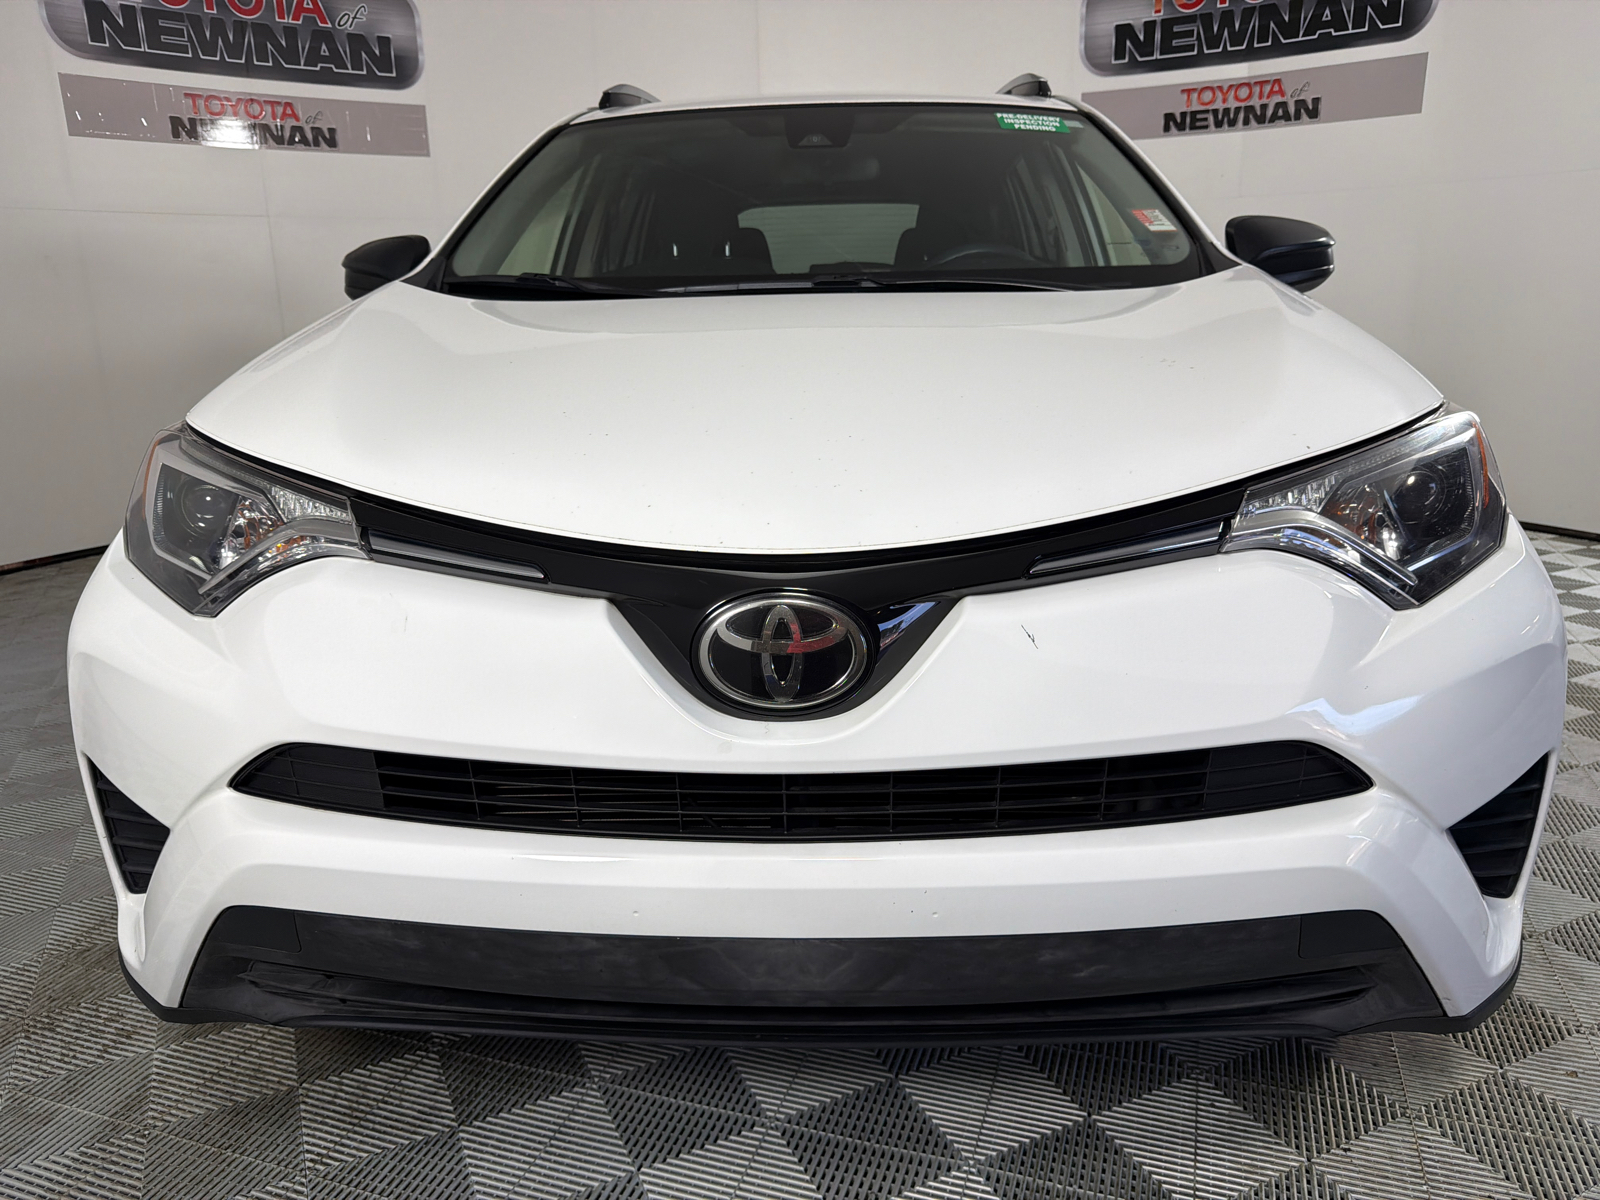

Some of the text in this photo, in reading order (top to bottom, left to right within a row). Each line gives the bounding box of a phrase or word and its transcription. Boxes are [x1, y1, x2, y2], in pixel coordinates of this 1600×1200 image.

[335, 4, 367, 30] of
[1112, 0, 1404, 64] NEWNAN
[83, 0, 396, 77] NEWNAN
[183, 92, 300, 122] TOYOTA
[1181, 78, 1286, 108] TOYOTA
[1004, 118, 1060, 127] INSPECTION
[1014, 123, 1056, 132] PENDING
[1163, 97, 1322, 133] NEWNAN
[169, 115, 338, 148] NNAN
